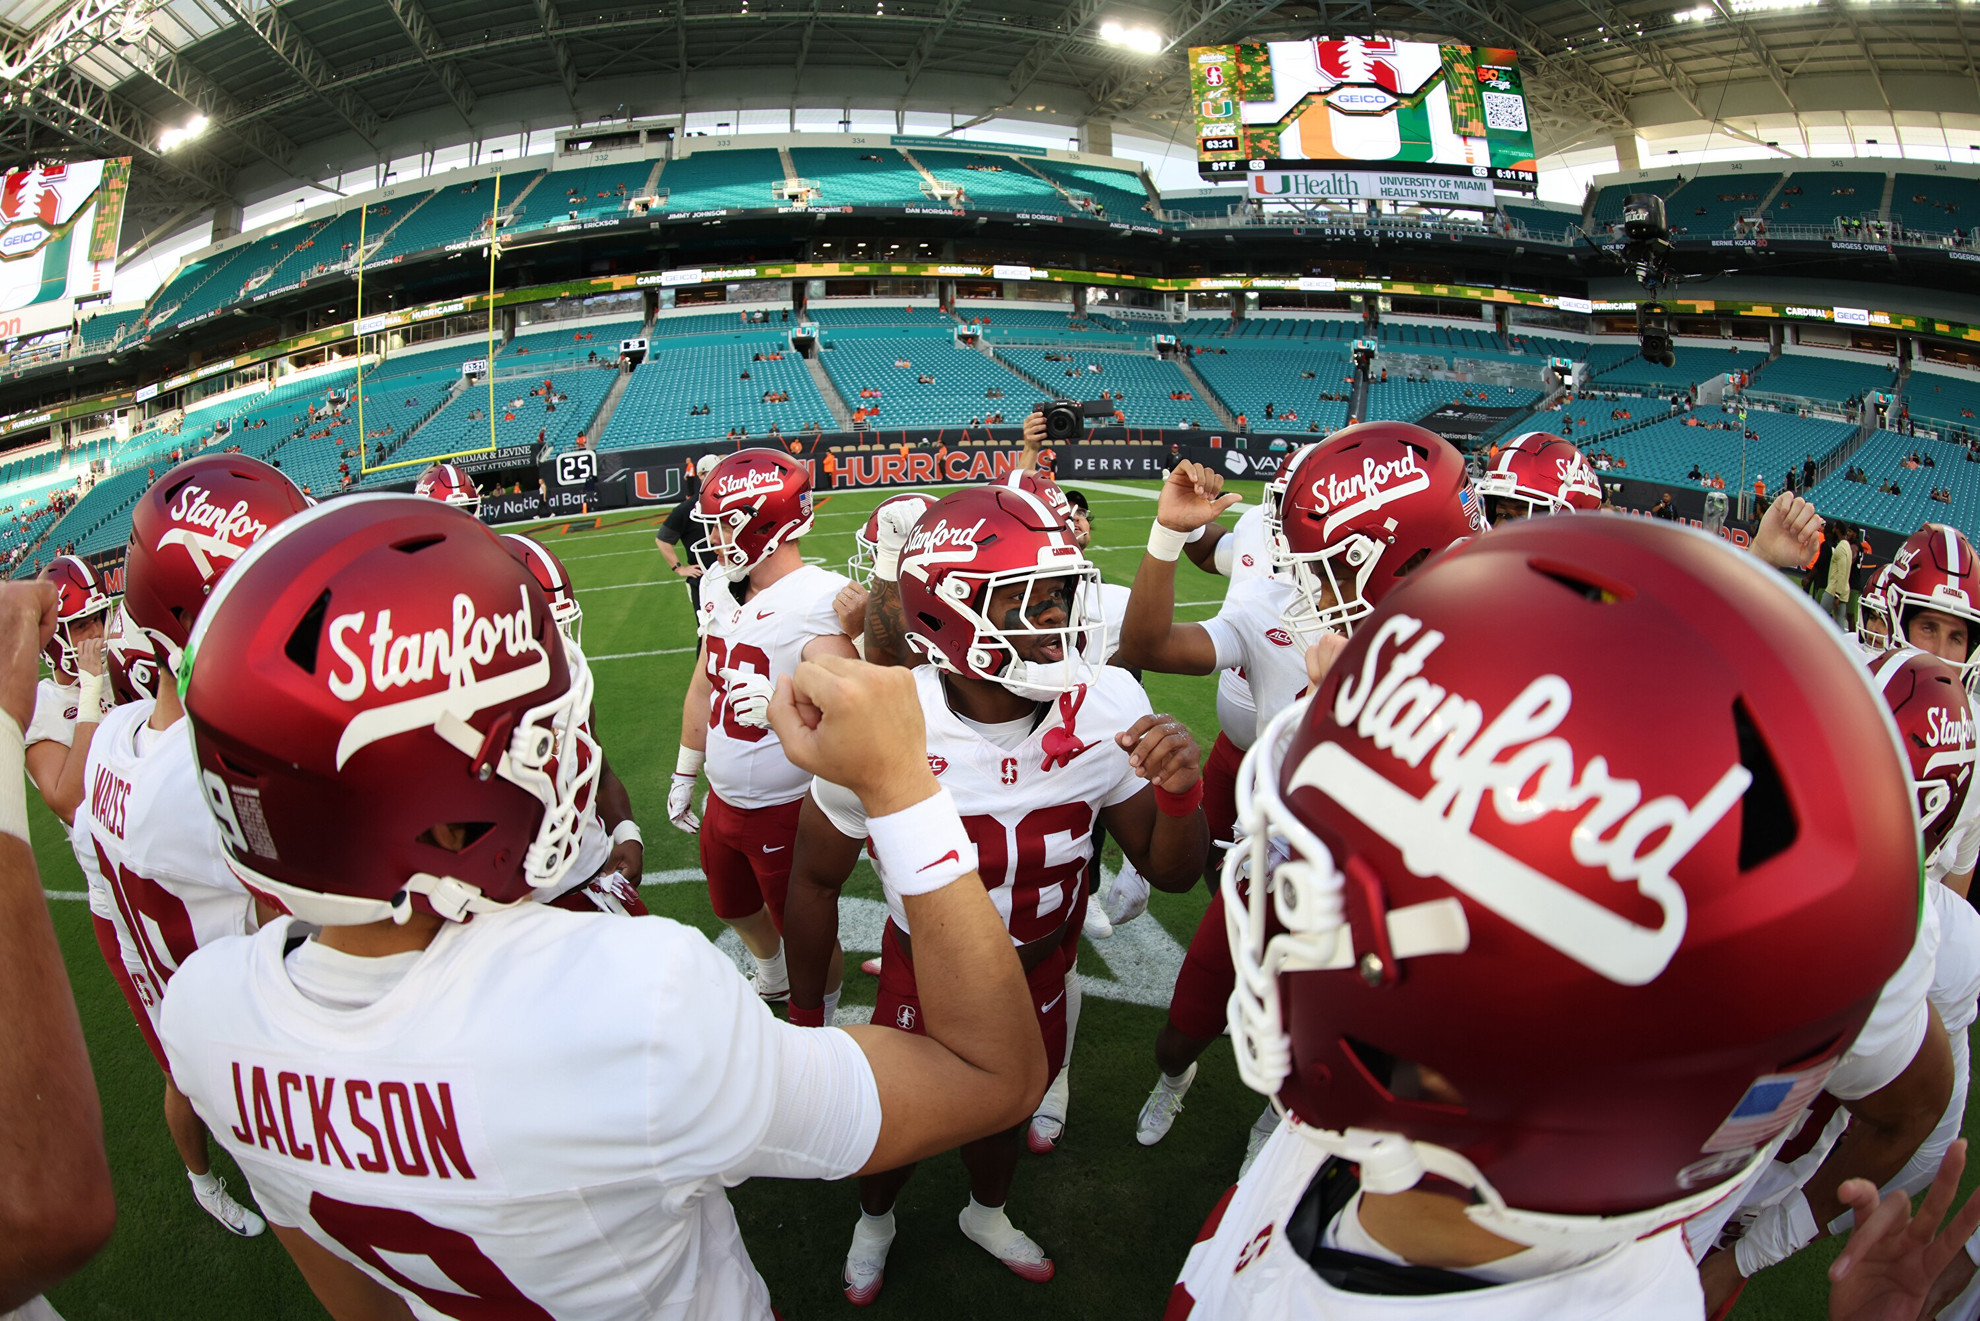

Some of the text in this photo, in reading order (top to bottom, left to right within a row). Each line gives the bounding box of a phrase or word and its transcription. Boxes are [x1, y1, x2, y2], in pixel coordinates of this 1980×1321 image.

[1338, 95, 1387, 103] GEICO
[1202, 100, 1233, 117] U
[1202, 125, 1236, 137] KICK
[1206, 140, 1233, 149] 63:21
[1250, 161, 1263, 169] CC
[1934, 163, 1947, 171] 344
[1474, 167, 1487, 176] CC
[1497, 169, 1534, 181] 6:01 PM
[1379, 176, 1487, 192] UNIVERSITY OF MIAMI
[383, 189, 395, 198] 330
[1380, 187, 1459, 201] HEALTH SYSTEM
[668, 209, 727, 220] JIMMY JOHNSON
[557, 219, 619, 232] DENNIS ERICKSON
[1109, 222, 1158, 234] ANDRE JOHNSON
[3, 230, 43, 247] GEICO
[1325, 228, 1432, 240] RING OF HONOR
[444, 241, 468, 252] CHUCK
[1711, 239, 1768, 247] BERNIE KOSAR 20
[1831, 242, 1862, 251] BURGESS
[1863, 244, 1887, 253] OWENS
[362, 259, 393, 271] ANDERSON
[938, 265, 983, 275] CARDINAL
[665, 273, 698, 282] GEICO
[701, 268, 757, 280] URRICANES
[998, 269, 1027, 277] GEICO
[1200, 279, 1242, 288] CARDINAL
[1562, 300, 1590, 310] GEICO
[411, 303, 464, 320] HURRICANES
[1786, 307, 1826, 319] CARDINAL
[1837, 311, 1866, 322] GEICO
[464, 361, 485, 372] 63:21
[11, 413, 52, 430] HURRICANES
[1440, 432, 1467, 440] National
[498, 446, 531, 458] LEVINE
[487, 458, 531, 471] ATTORNEYS
[562, 456, 591, 481] 25
[1075, 458, 1134, 470] PERRY
[634, 468, 681, 500] U
[718, 465, 780, 497] Stanford
[1311, 446, 1417, 515] Stanford
[504, 494, 559, 514] Natioal
[170, 485, 268, 544] Stanfor
[904, 518, 987, 555] Stanford
[327, 584, 538, 703] Stanford
[1334, 613, 1753, 900] Stanford
[91, 763, 132, 840] WAISS
[231, 1062, 477, 1180] JACKSON
